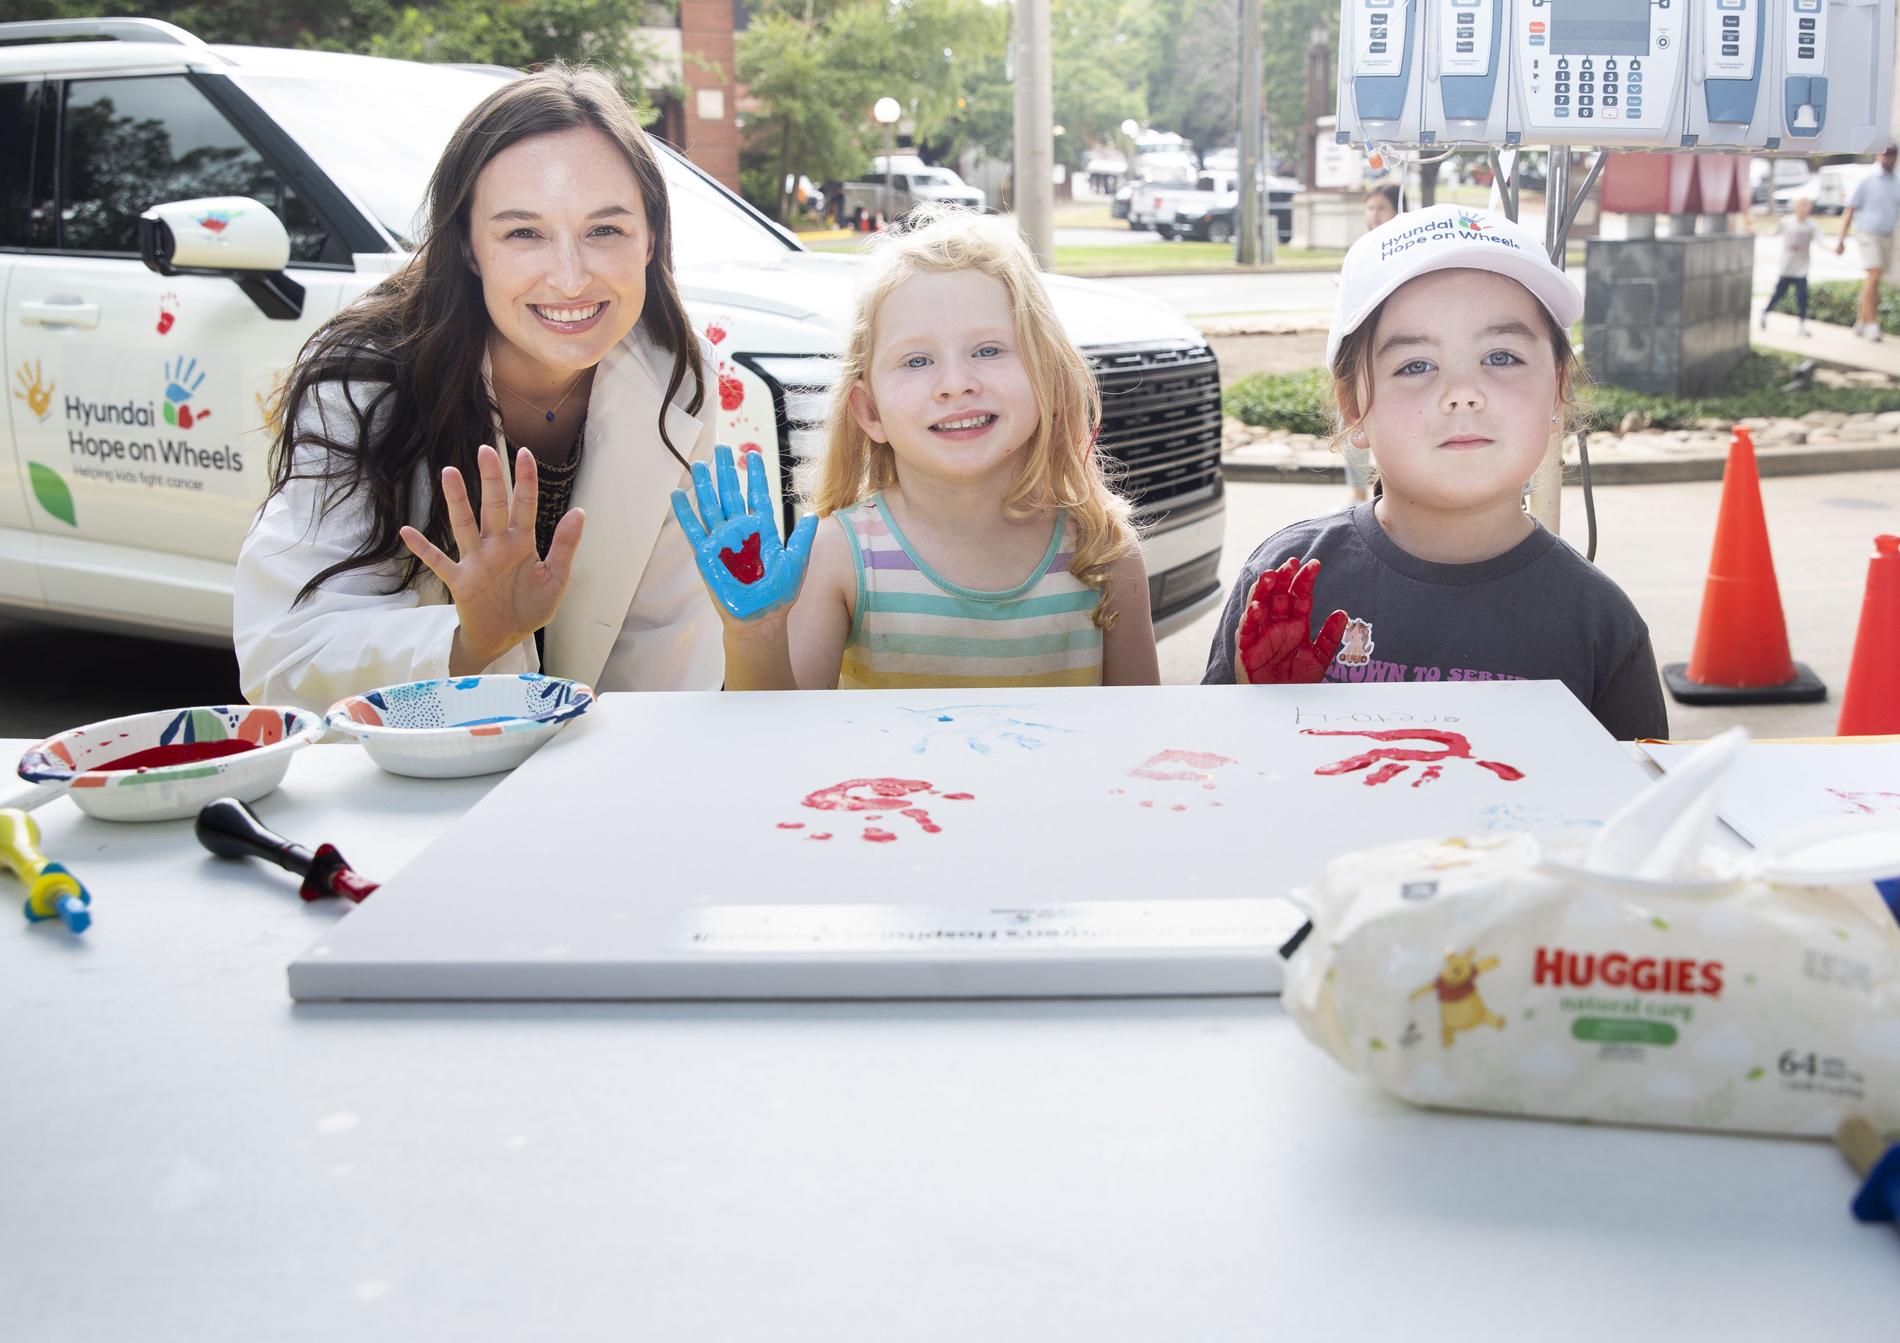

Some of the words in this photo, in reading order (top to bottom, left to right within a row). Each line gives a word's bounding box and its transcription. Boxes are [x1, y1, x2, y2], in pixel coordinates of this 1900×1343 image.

[1381, 218, 1454, 251] Hyundai
[1381, 235, 1427, 261] Hope
[1432, 230, 1455, 241] on
[1458, 230, 1521, 250] Wheels
[65, 395, 155, 427] Hyundai
[68, 430, 125, 462] Hope
[129, 439, 156, 462] on
[158, 438, 244, 473] Wheels
[73, 464, 114, 483] Helping
[115, 467, 137, 482] kids
[138, 470, 163, 489] fight
[165, 476, 204, 492] cancer
[1413, 666, 1442, 682] TO
[1533, 947, 1724, 995] HUGGIES
[1559, 996, 1641, 1013] natural
[1777, 1048, 1817, 1077] 64
